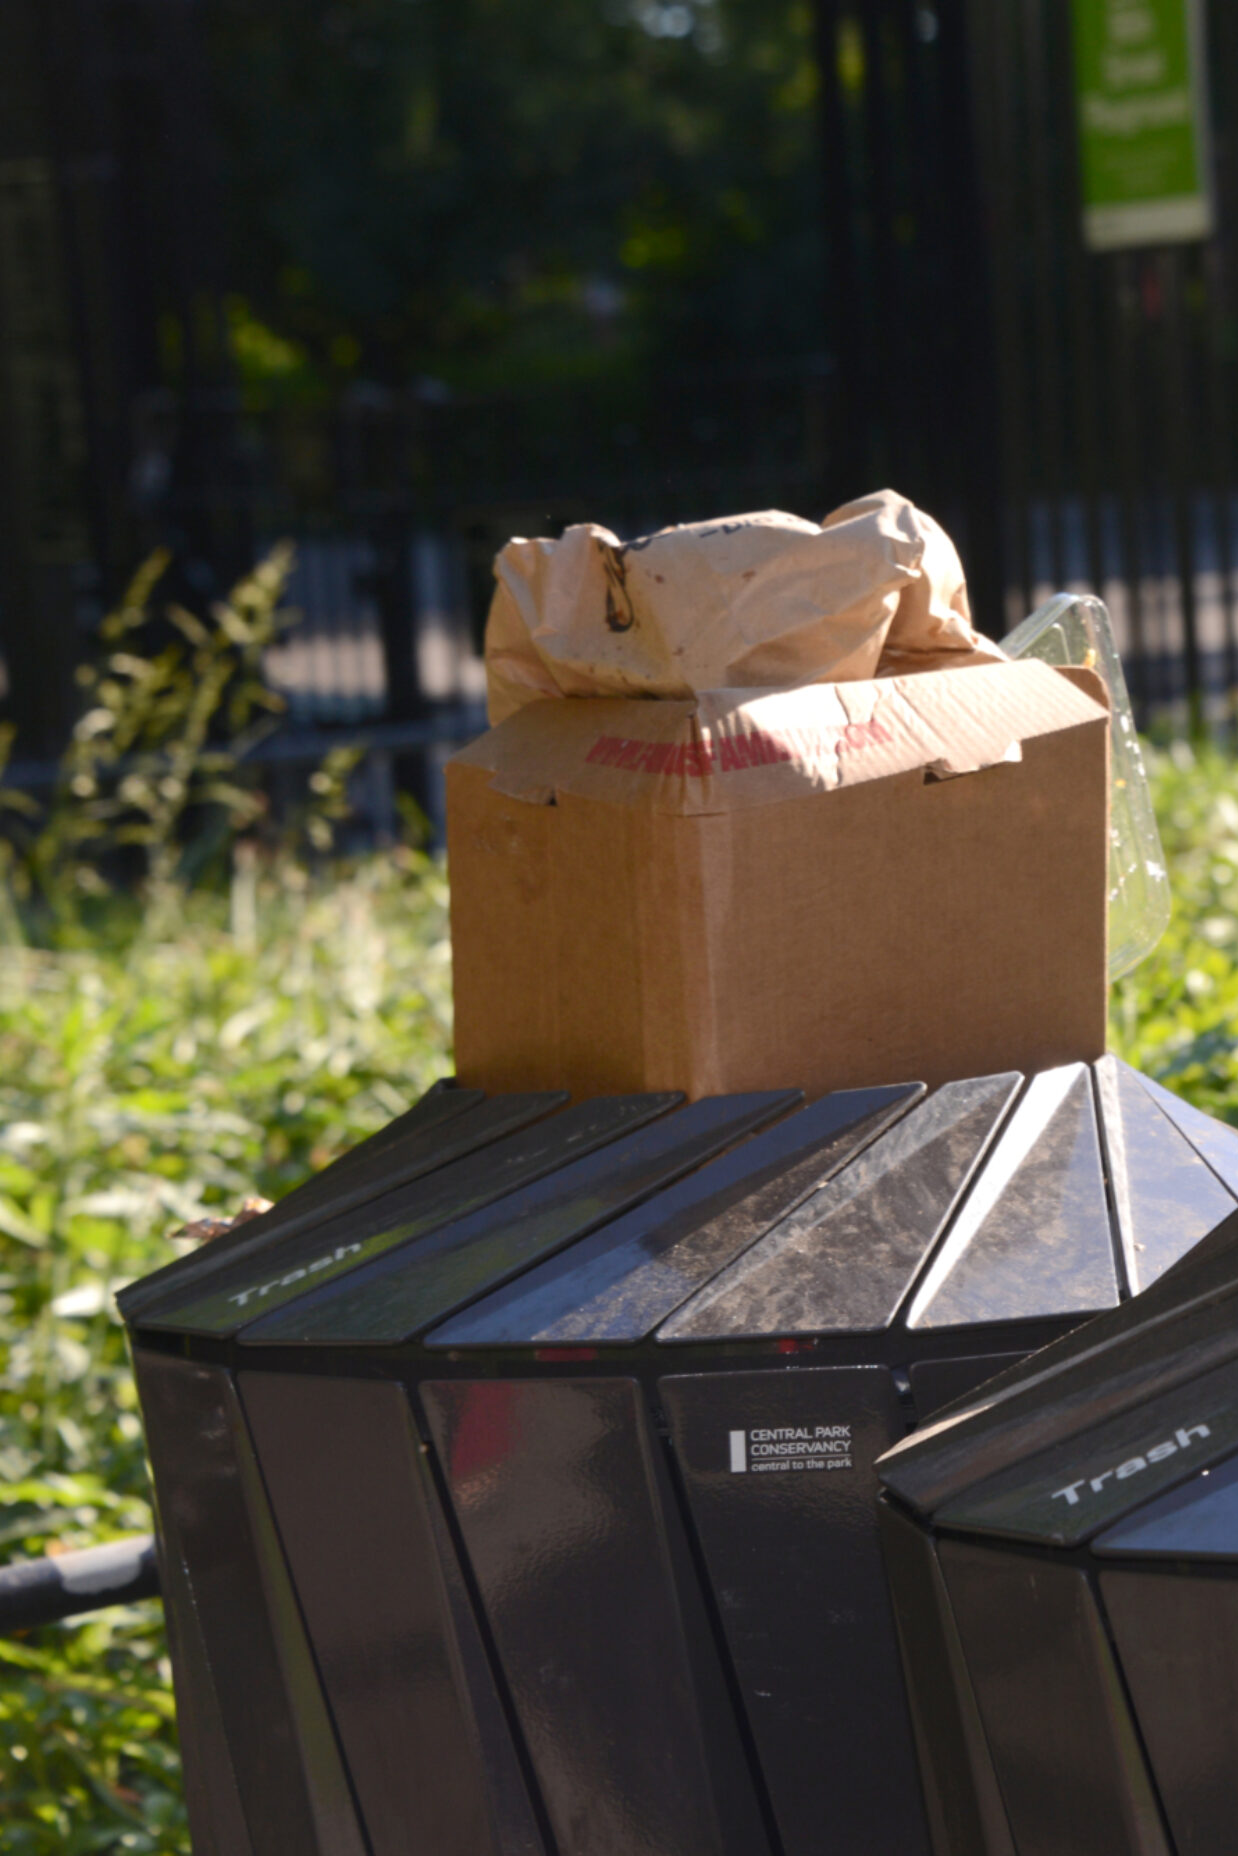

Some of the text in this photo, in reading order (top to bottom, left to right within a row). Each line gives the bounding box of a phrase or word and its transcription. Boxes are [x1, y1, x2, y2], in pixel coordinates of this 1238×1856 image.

[228, 1243, 361, 1306] Trash
[751, 1426, 851, 1441] CENTRAL PARK
[751, 1440, 851, 1456] CONSERVANCY
[751, 1457, 852, 1472] central to the park
[1051, 1424, 1211, 1505] Trash
